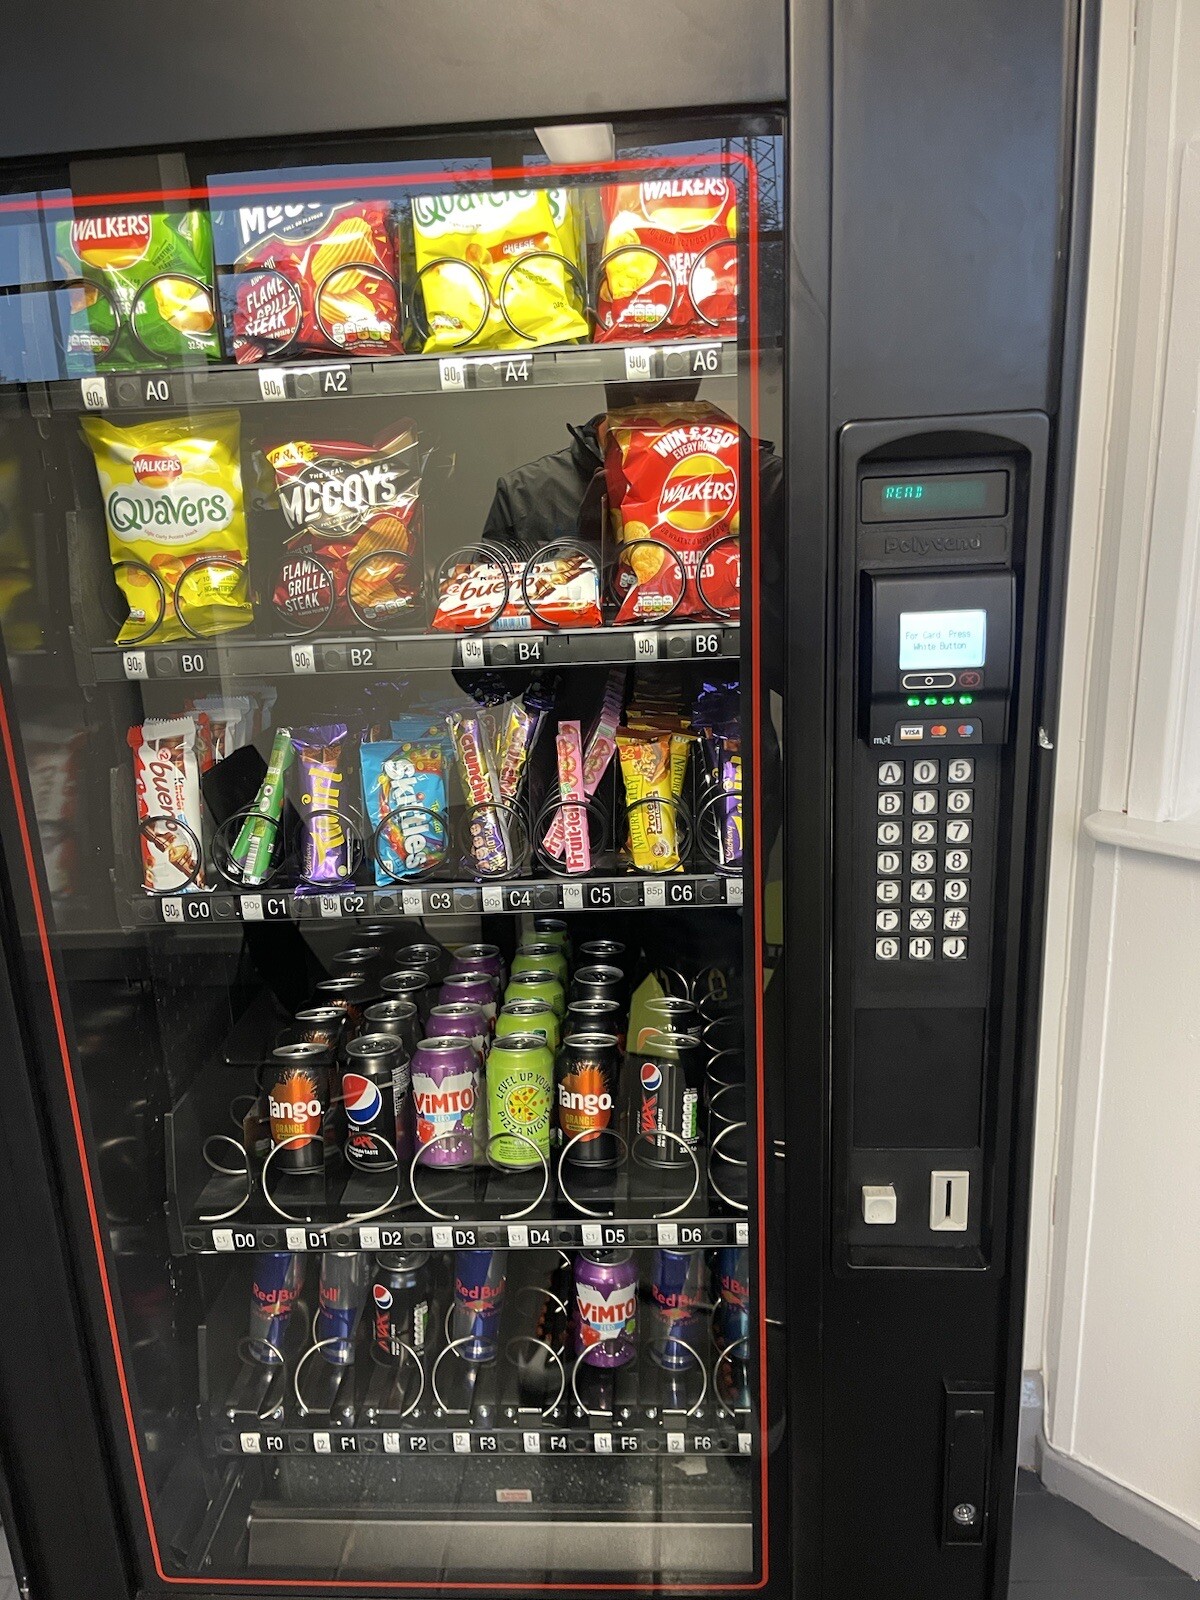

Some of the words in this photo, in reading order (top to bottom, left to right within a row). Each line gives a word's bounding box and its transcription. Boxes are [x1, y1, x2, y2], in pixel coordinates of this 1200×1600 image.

[644, 179, 726, 199] WALKERS
[73, 214, 149, 241] WALKERS
[503, 239, 535, 254] CHEESE
[629, 353, 647, 370] 90p
[693, 350, 718, 371] A6
[443, 366, 463, 384] 90p
[505, 361, 529, 383] A4
[263, 380, 282, 398] 90p
[324, 371, 348, 393] A2
[146, 380, 169, 401] A0
[86, 390, 105, 408] 90p
[653, 428, 689, 458] WIN
[672, 441, 697, 460] EVERY
[133, 455, 182, 474] WALKERS
[663, 480, 735, 504] WALKERS
[884, 532, 982, 556] Polyvend
[460, 576, 535, 601] bueno
[285, 592, 320, 613] STEAK
[905, 631, 919, 640] For
[922, 631, 941, 640] Card
[948, 629, 972, 639] Press
[466, 641, 481, 658] 90p
[518, 643, 541, 661] B4
[638, 639, 655, 656] 90p
[696, 635, 719, 653] B6
[913, 642, 937, 651] White
[940, 641, 967, 651] Button
[127, 656, 143, 673] 90p
[182, 655, 204, 673] B0
[295, 654, 311, 671] 90p
[352, 650, 374, 667] B2
[884, 765, 896, 781] A
[955, 763, 965, 779] 5
[149, 762, 178, 832] bueno
[884, 796, 895, 812] B
[920, 795, 927, 811] 1
[953, 794, 964, 809] 6
[646, 791, 656, 836] Proten
[563, 792, 585, 869] Fruit-tela
[630, 812, 647, 851] NATURE
[883, 825, 894, 841] C
[918, 824, 928, 840] 2
[953, 824, 963, 839] 7
[883, 855, 894, 870] D
[918, 854, 927, 870] 3
[952, 853, 962, 869] 8
[509, 890, 531, 907] C4
[590, 888, 612, 904] C5
[645, 886, 663, 897] 85p
[671, 885, 693, 901] C6
[883, 884, 893, 899] E
[917, 883, 927, 898] 4
[951, 883, 961, 898] 9
[243, 900, 261, 911] 90p
[267, 899, 287, 915] C1
[323, 898, 338, 912] 90p
[343, 896, 365, 913] C2
[430, 893, 451, 910] C3
[484, 897, 501, 908] 90p
[164, 904, 180, 918] 90p
[187, 903, 210, 919] C0
[883, 913, 892, 928] F
[882, 940, 892, 956] G
[915, 940, 925, 956] H
[949, 939, 959, 955] J
[496, 1076, 517, 1100] LEVEL
[519, 1072, 534, 1082] UP
[498, 1110, 524, 1137] PIZZA
[526, 1107, 551, 1136] NIGHT
[565, 1114, 595, 1126] ORANGE
[275, 1123, 305, 1134] ORANGE
[235, 1233, 256, 1248] D0
[309, 1232, 328, 1247] D1
[382, 1231, 403, 1246] D2
[456, 1231, 476, 1245] D3
[530, 1229, 551, 1244] D4
[605, 1229, 626, 1244] D5
[681, 1228, 702, 1243] D6
[266, 1436, 283, 1451] F0
[340, 1437, 356, 1451] F1
[410, 1436, 427, 1451] F2
[480, 1437, 497, 1451] F3
[550, 1436, 567, 1451] F4
[621, 1436, 638, 1451] F5
[694, 1436, 712, 1451] F6
